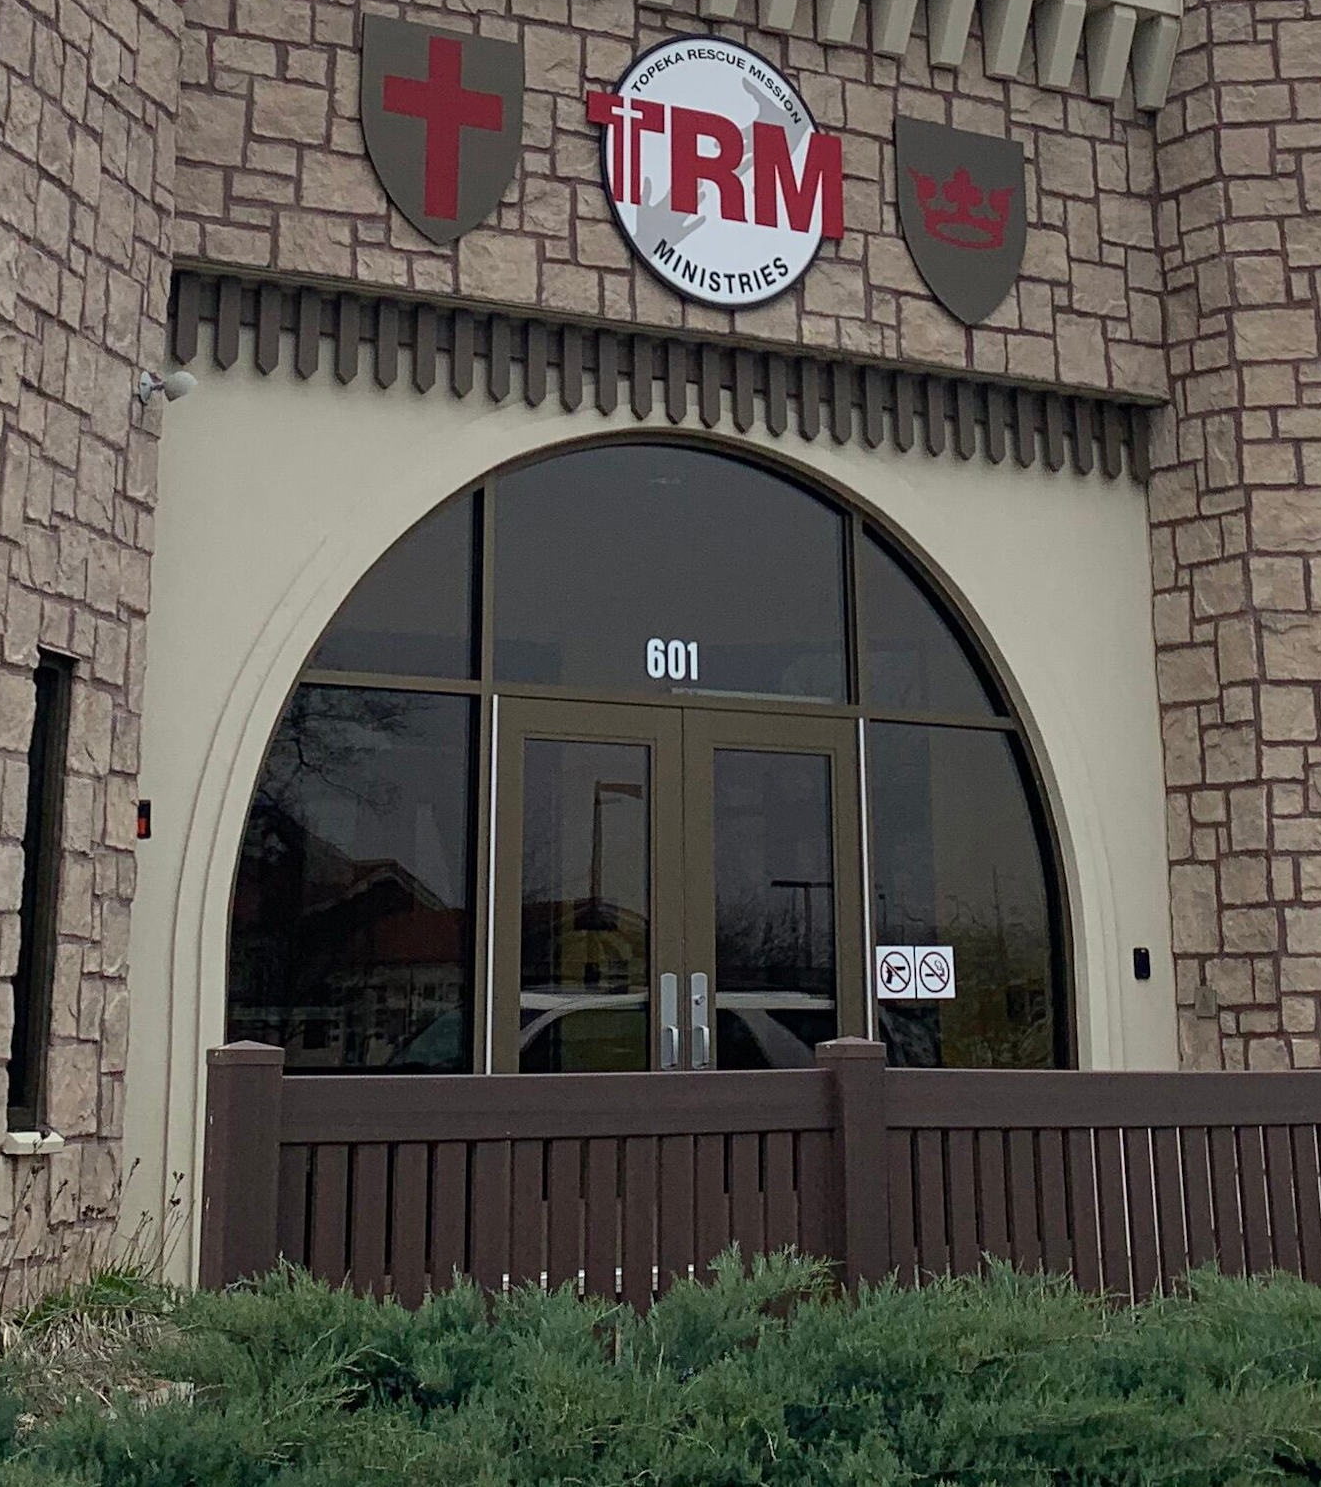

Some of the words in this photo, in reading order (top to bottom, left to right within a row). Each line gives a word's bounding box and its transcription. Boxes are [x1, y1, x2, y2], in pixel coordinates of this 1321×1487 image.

[630, 51, 685, 94] TOPEKA
[687, 47, 746, 70] RESCUE
[748, 64, 801, 125] MISSION
[586, 89, 845, 240] TRM
[652, 237, 790, 295] MINISTRIES
[645, 637, 699, 682] 601
